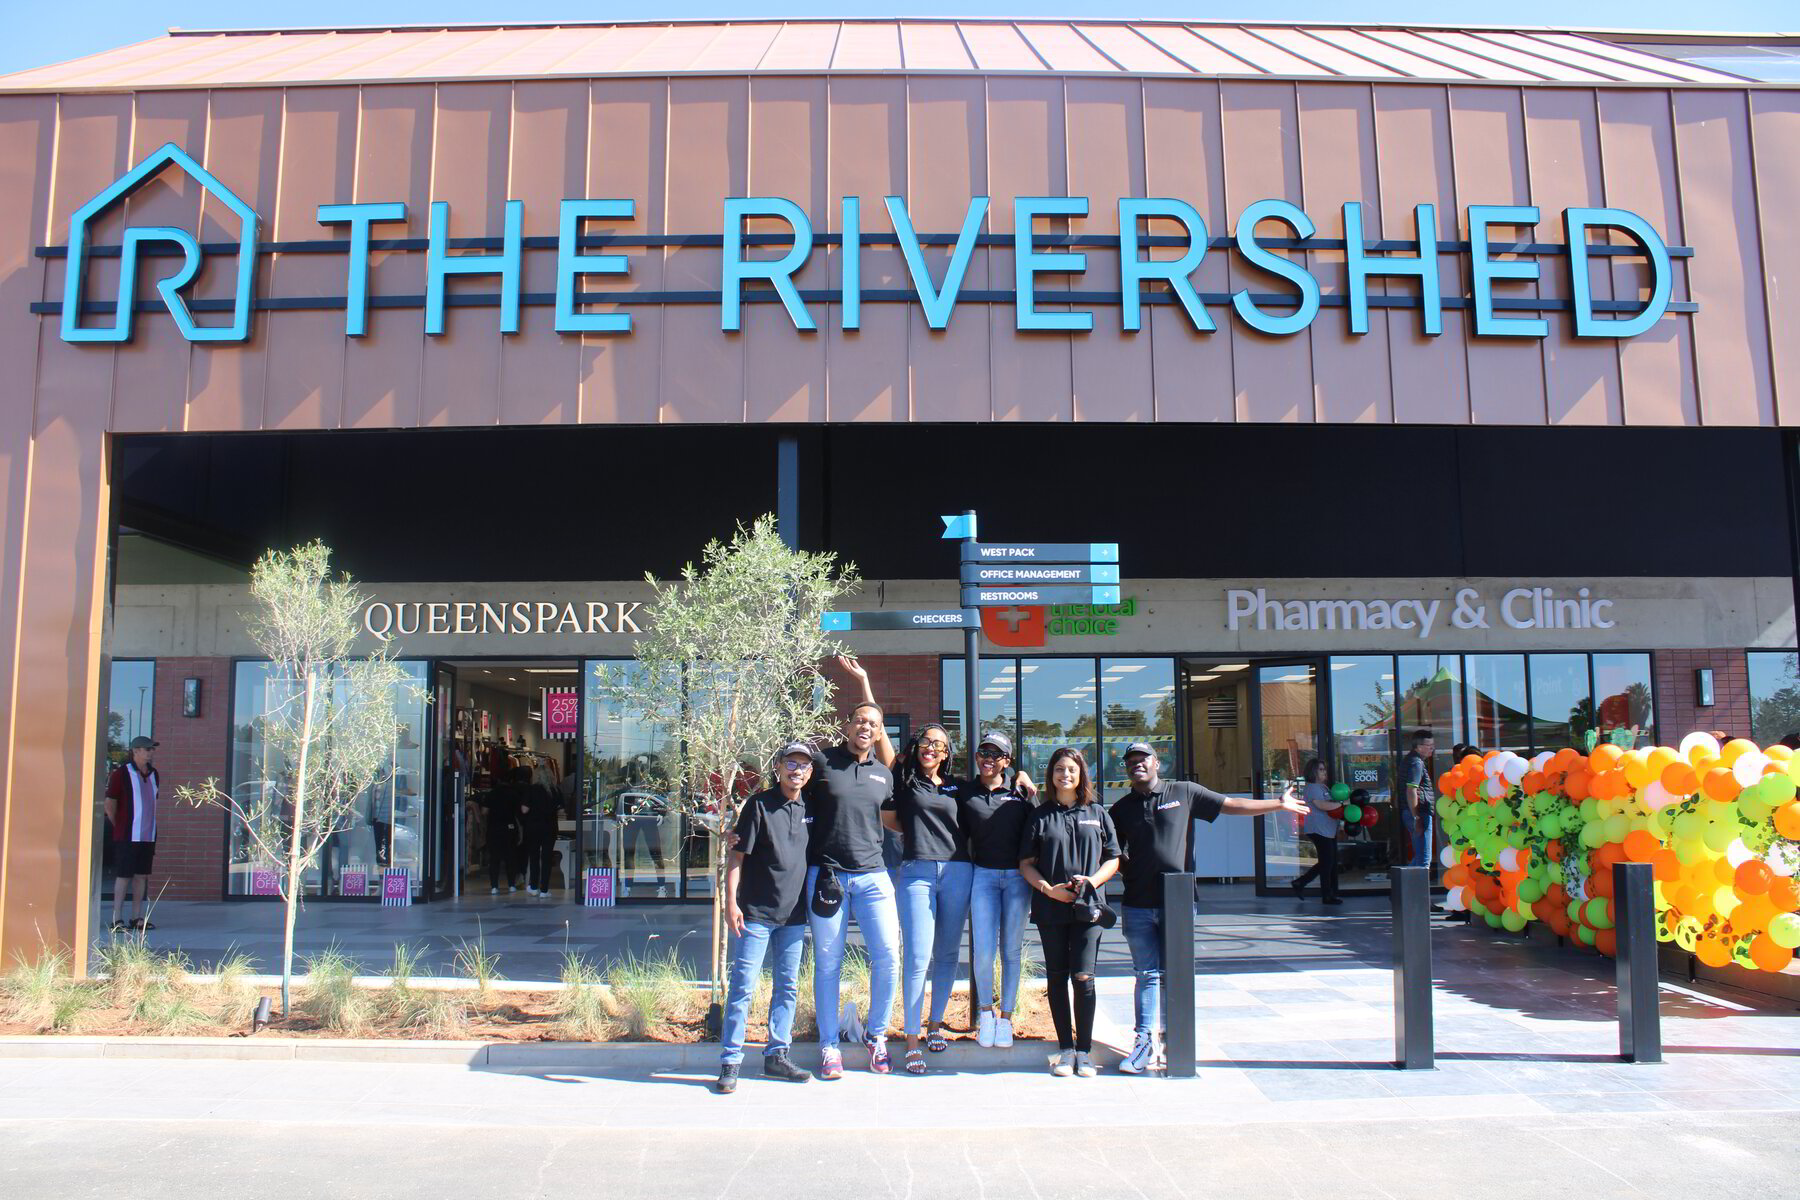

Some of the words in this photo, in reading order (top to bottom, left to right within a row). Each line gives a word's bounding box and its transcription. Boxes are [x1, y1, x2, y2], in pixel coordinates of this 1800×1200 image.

[317, 198, 636, 338] THE
[721, 195, 1673, 341] RIVERSHED
[980, 548, 1009, 557] WEST
[1009, 548, 1035, 557] PACK
[980, 570, 1014, 579] OFFICE
[1015, 570, 1081, 579] MANAGEMENT
[980, 591, 1039, 601] RESTROOMS
[1226, 588, 1440, 639] Pharmacy
[1451, 587, 1491, 631] &
[1501, 586, 1617, 631] Clinic
[364, 602, 644, 641] QUEENSPARK
[912, 614, 963, 624] CHECKERS
[1050, 616, 1121, 636] choice
[552, 698, 578, 712] 25%
[1354, 774, 1378, 782] SOON
[256, 871, 278, 880] 25%
[346, 874, 363, 882] 25%
[256, 880, 278, 889] OFF
[345, 882, 363, 890] OFF
[387, 878, 405, 886] 25%
[591, 878, 609, 887] 25%
[387, 885, 405, 894] OFF
[591, 885, 609, 893] OFF
